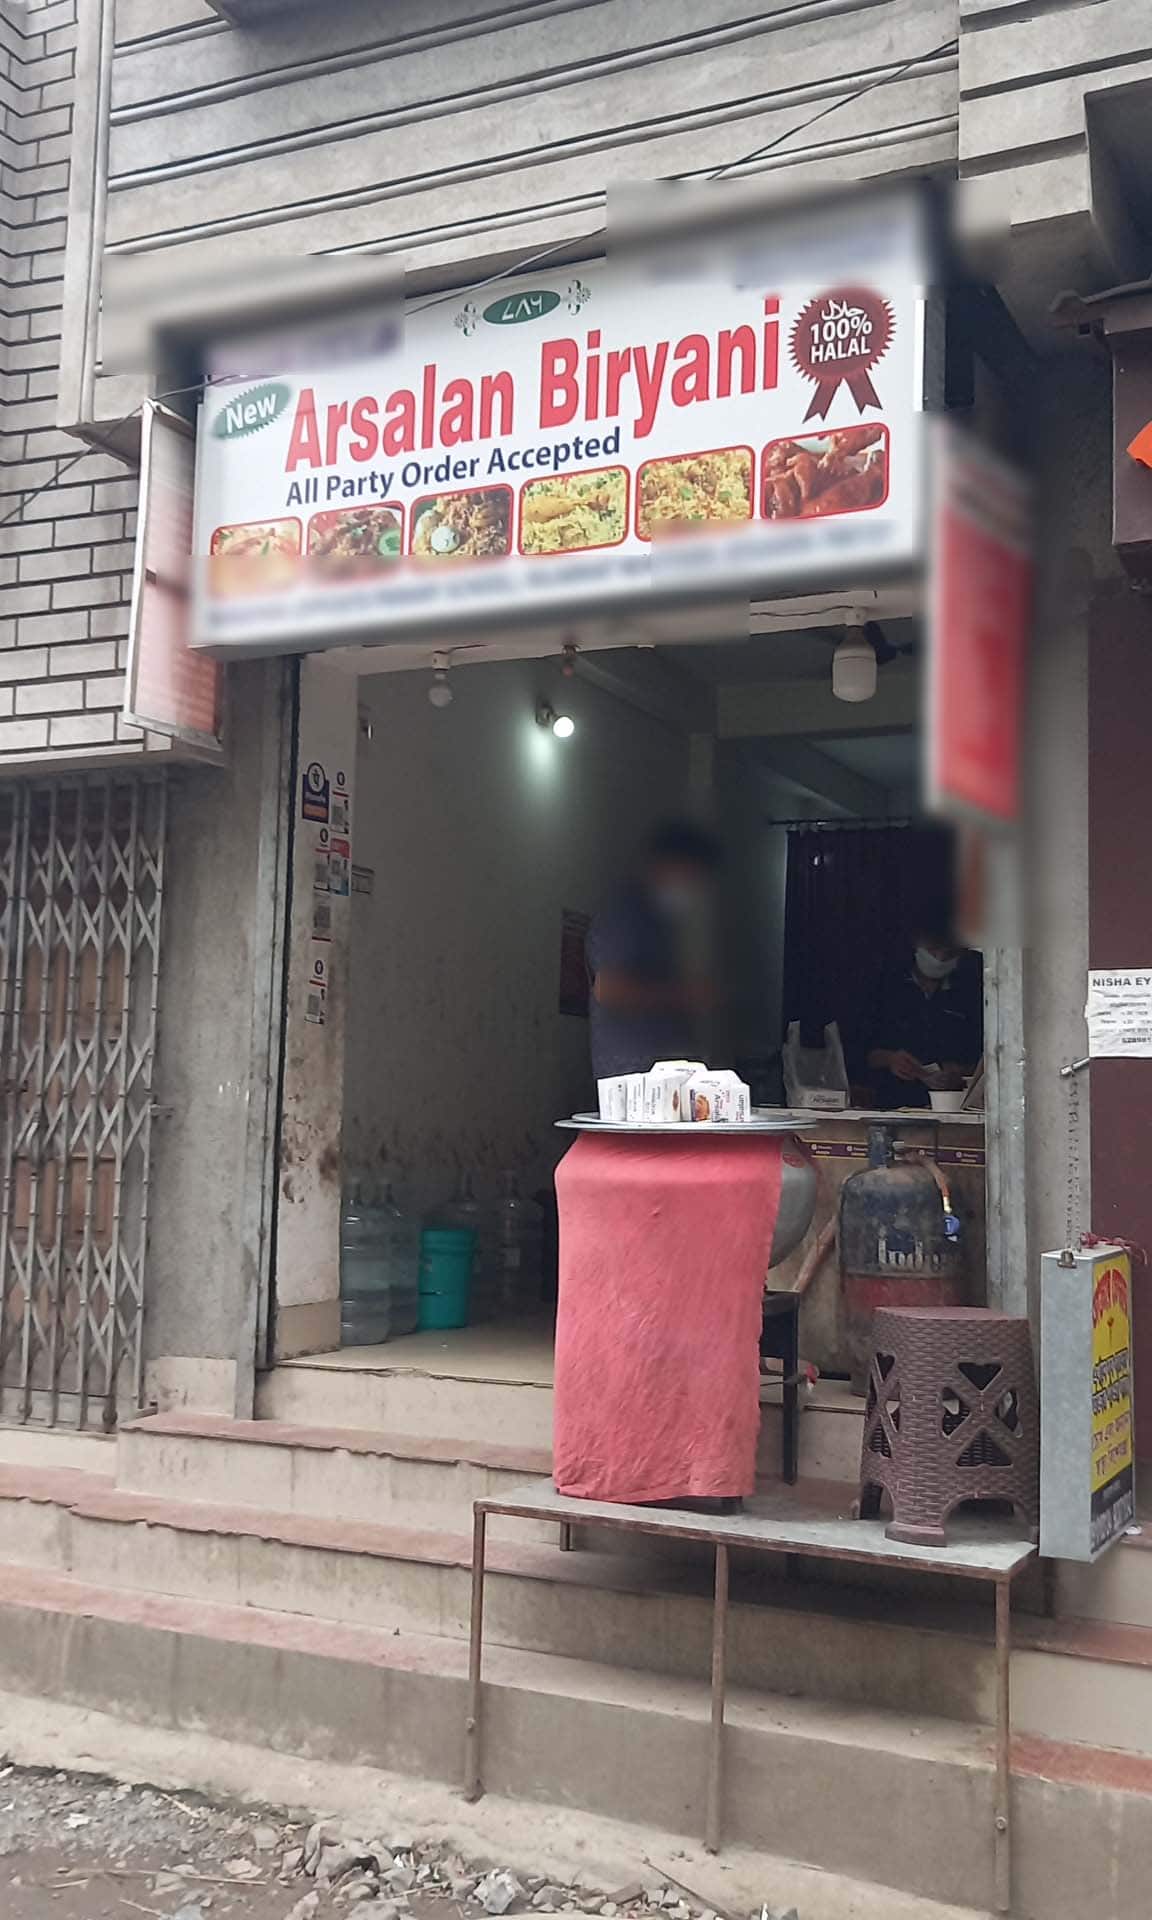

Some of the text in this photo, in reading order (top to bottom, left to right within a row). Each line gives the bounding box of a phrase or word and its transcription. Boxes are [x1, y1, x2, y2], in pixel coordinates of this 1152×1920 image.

[810, 314, 873, 345] 100%
[810, 336, 872, 364] HALAL
[285, 293, 780, 473] Arsalan Biryani
[225, 392, 277, 434] New
[286, 425, 621, 507] All Party Order Accepted
[1092, 977, 1132, 987] NISHA
